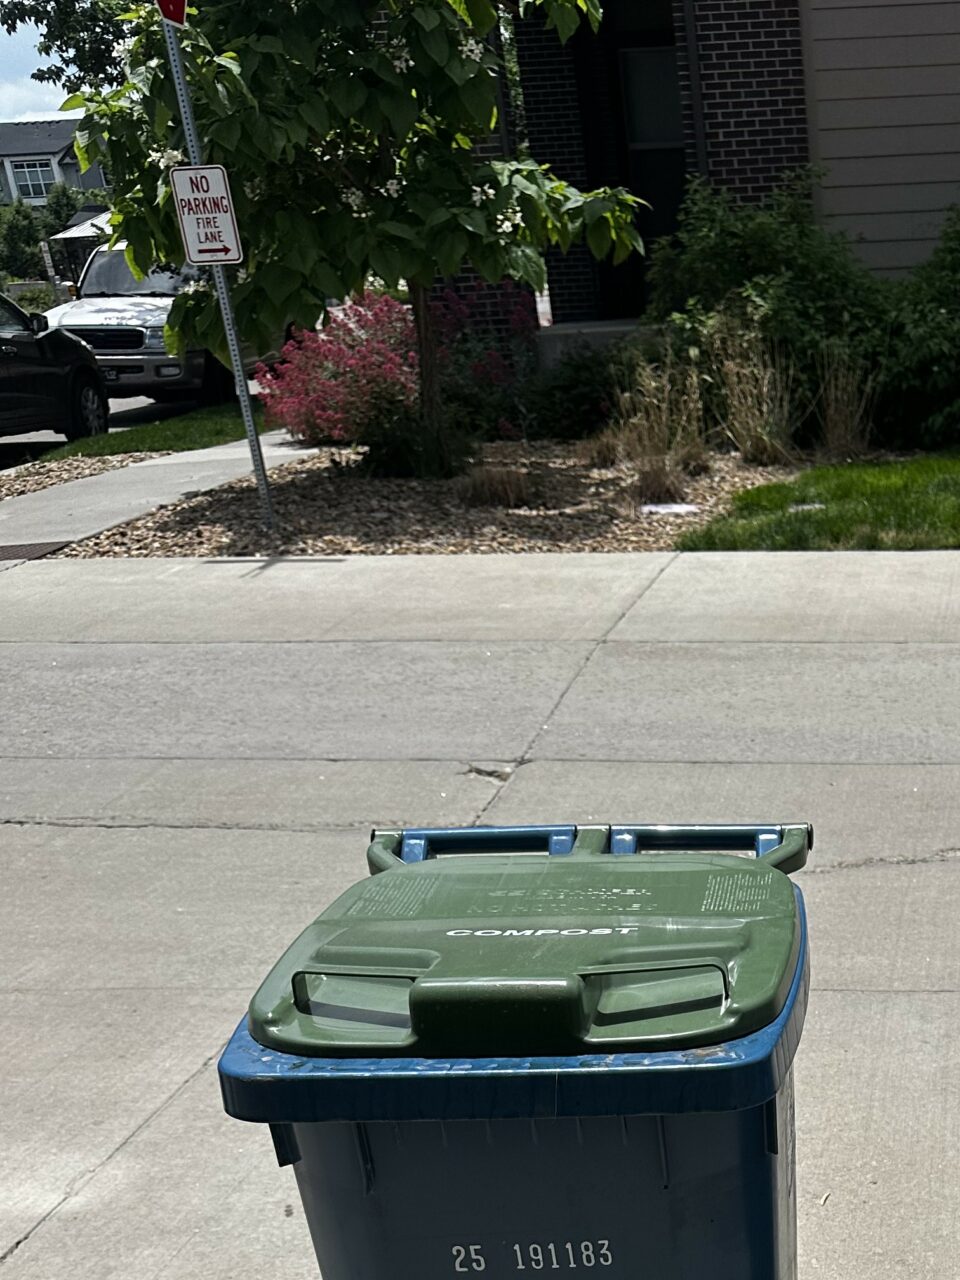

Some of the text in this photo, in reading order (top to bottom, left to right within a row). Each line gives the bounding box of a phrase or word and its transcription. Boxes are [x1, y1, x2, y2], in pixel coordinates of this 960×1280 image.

[189, 175, 210, 193] NO
[180, 196, 229, 216] PARKING
[196, 217, 220, 229] FIRE
[197, 231, 224, 243] LANE
[445, 926, 639, 937] COMPOST
[452, 1240, 613, 1272] 25 191183
